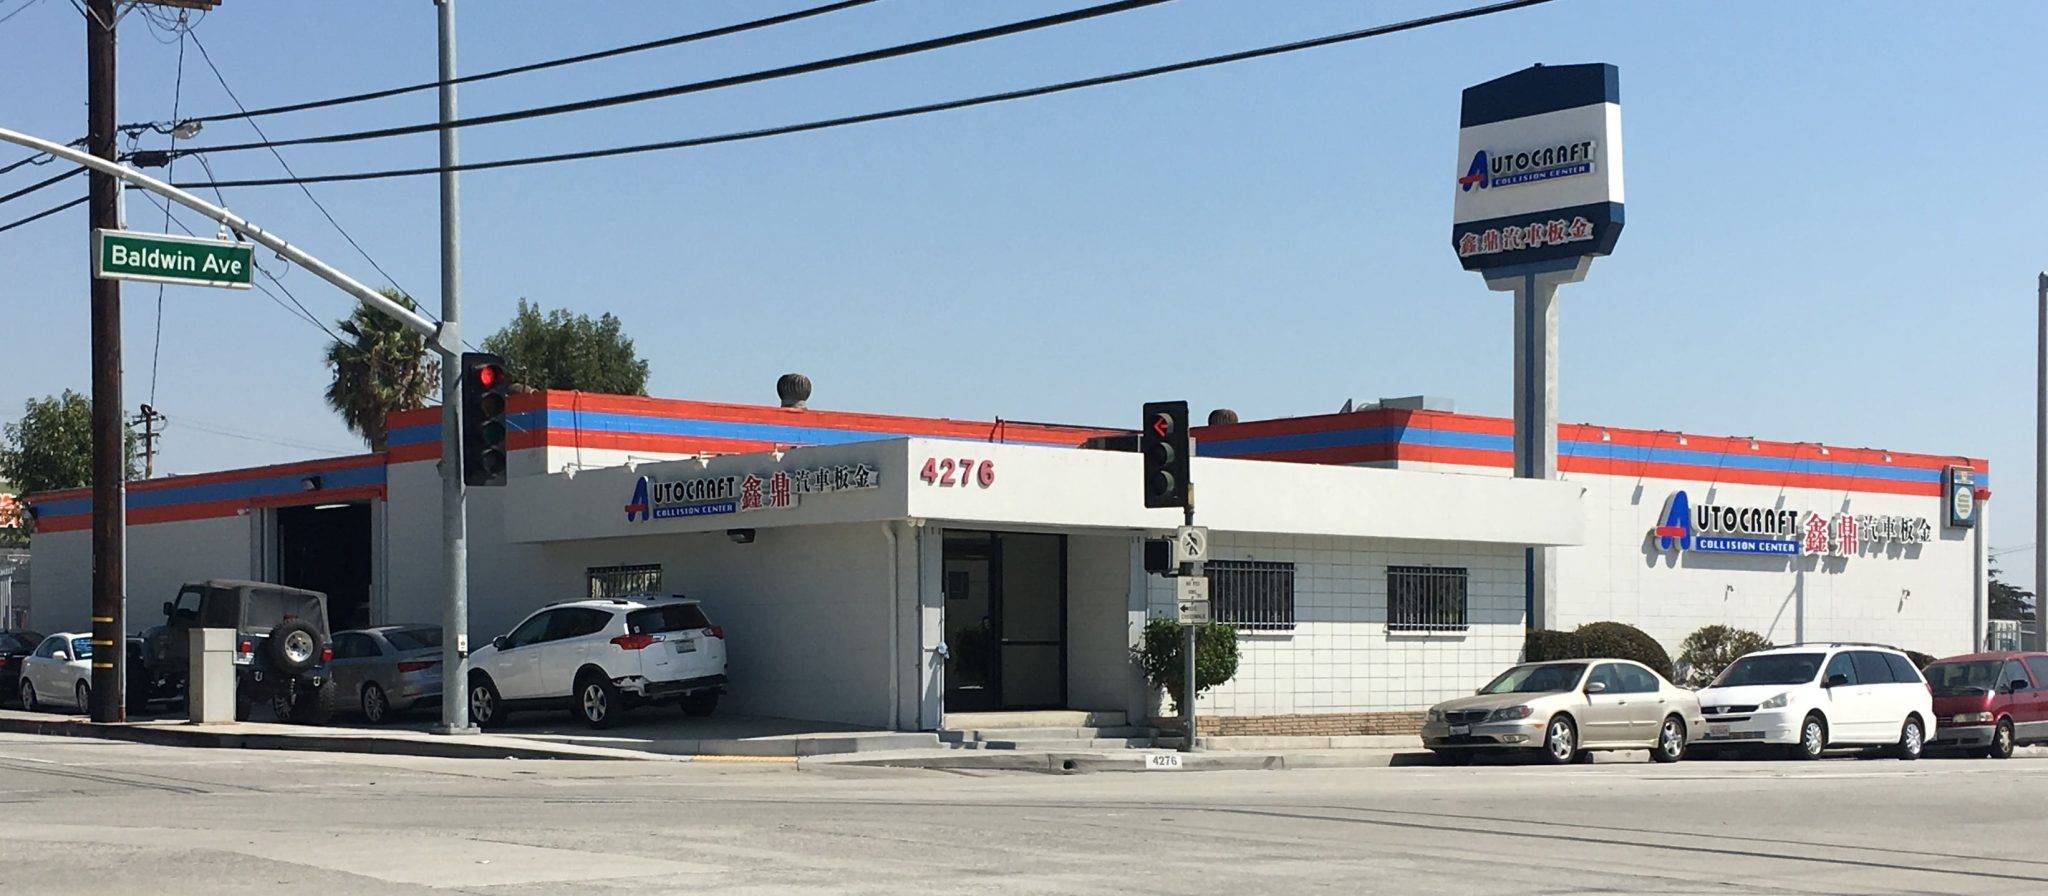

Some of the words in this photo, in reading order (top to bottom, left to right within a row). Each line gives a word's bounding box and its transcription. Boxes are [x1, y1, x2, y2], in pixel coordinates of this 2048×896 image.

[1459, 141, 1593, 192] AUTOCRAFT
[1495, 172, 1547, 186] COLLISION
[1550, 165, 1586, 177] CENTER
[112, 245, 195, 271] Baldwin
[202, 253, 242, 275] Ave
[920, 457, 995, 489] 4276
[625, 476, 735, 522] AUTOCRAFT
[656, 506, 700, 518] COLLISION
[703, 503, 733, 514] CENTER
[1655, 490, 1798, 550] AUTOCRAFT
[1700, 539, 1755, 551] COLLISION
[1758, 541, 1795, 553] CENTER
[1153, 755, 1178, 766] 4276
